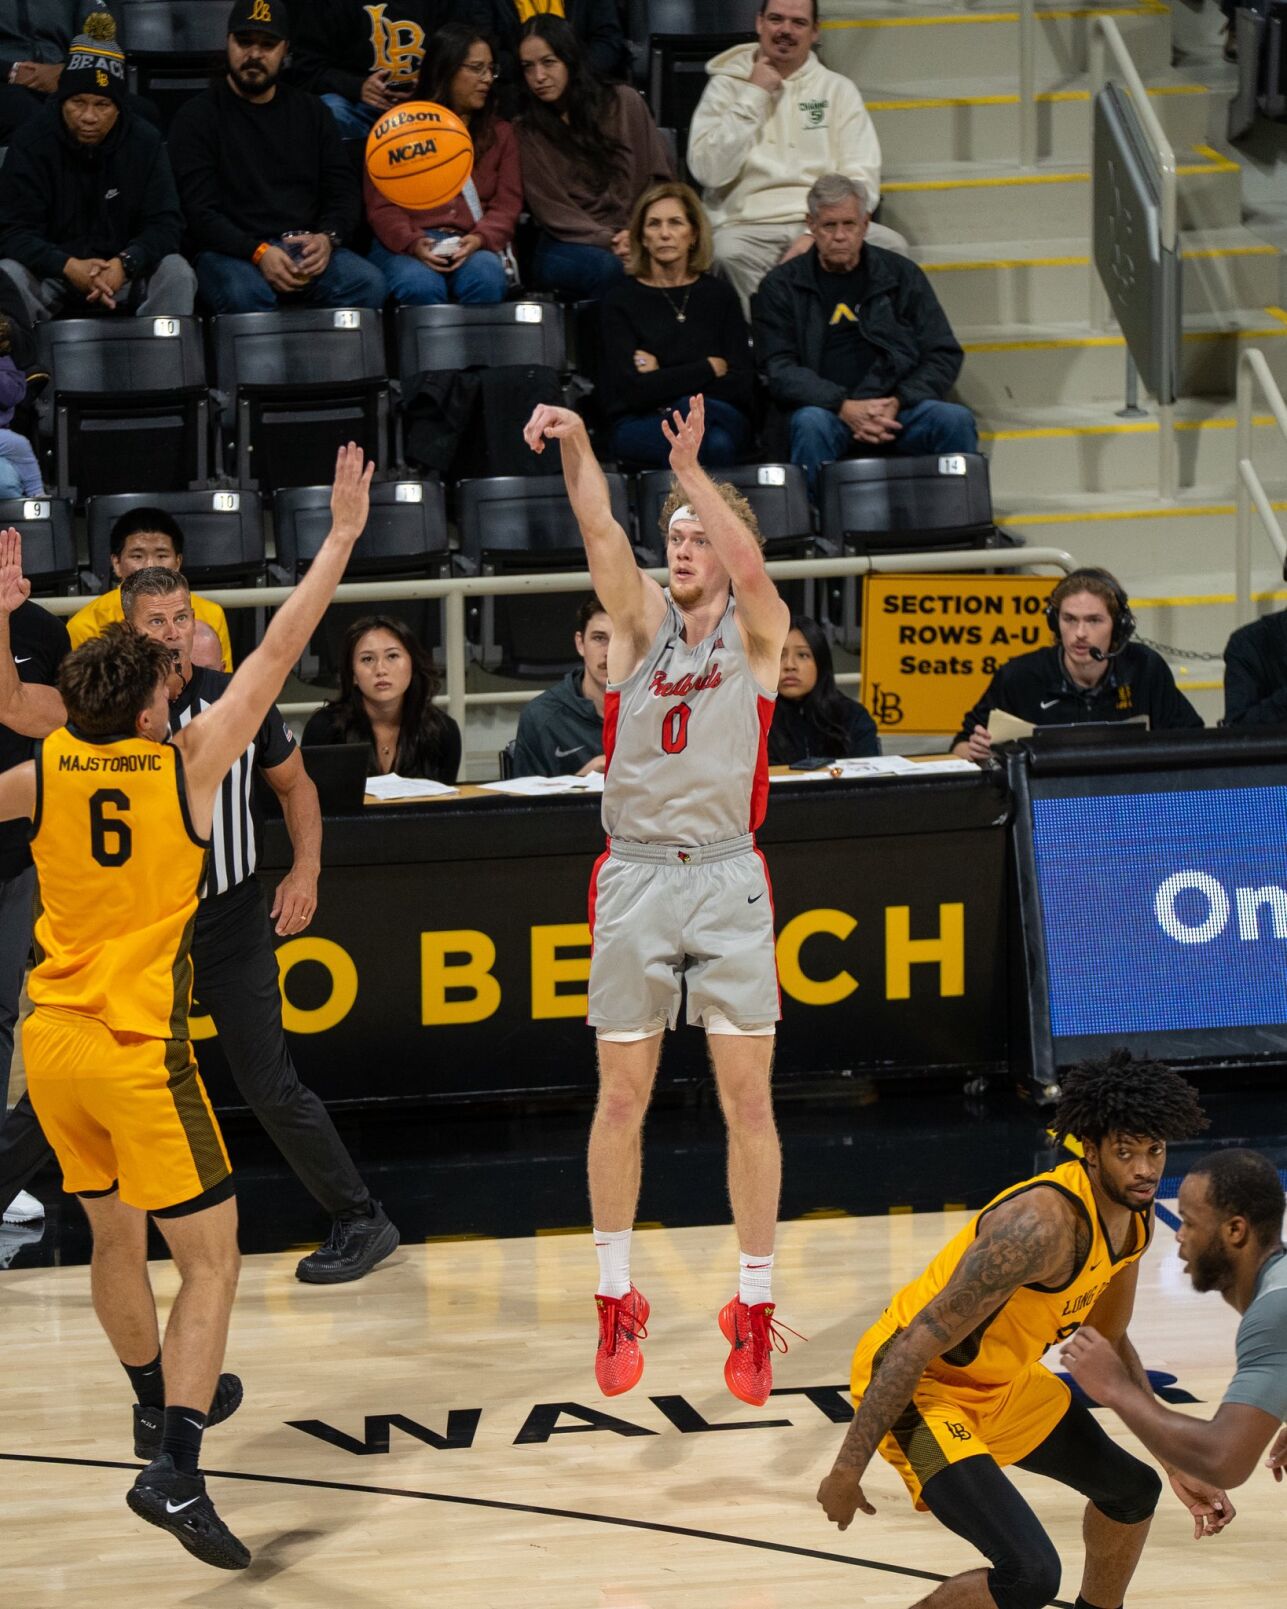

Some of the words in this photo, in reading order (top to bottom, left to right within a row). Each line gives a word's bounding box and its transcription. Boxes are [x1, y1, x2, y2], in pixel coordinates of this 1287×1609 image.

[374, 112, 441, 140] Wilson
[388, 139, 438, 166] NCAA
[945, 459, 959, 473] 14
[33, 502, 42, 517] 9
[220, 494, 234, 509] 10
[883, 594, 1004, 615] SECTION
[898, 625, 983, 645] ROWS
[990, 625, 1040, 646] A-U
[899, 655, 974, 675] Seats
[871, 682, 904, 725] LB
[661, 701, 692, 755] 0
[58, 754, 162, 773] MAJSTOROVIC
[88, 788, 133, 868] 6
[420, 902, 965, 1026] BECH
[942, 1420, 972, 1442] LB
